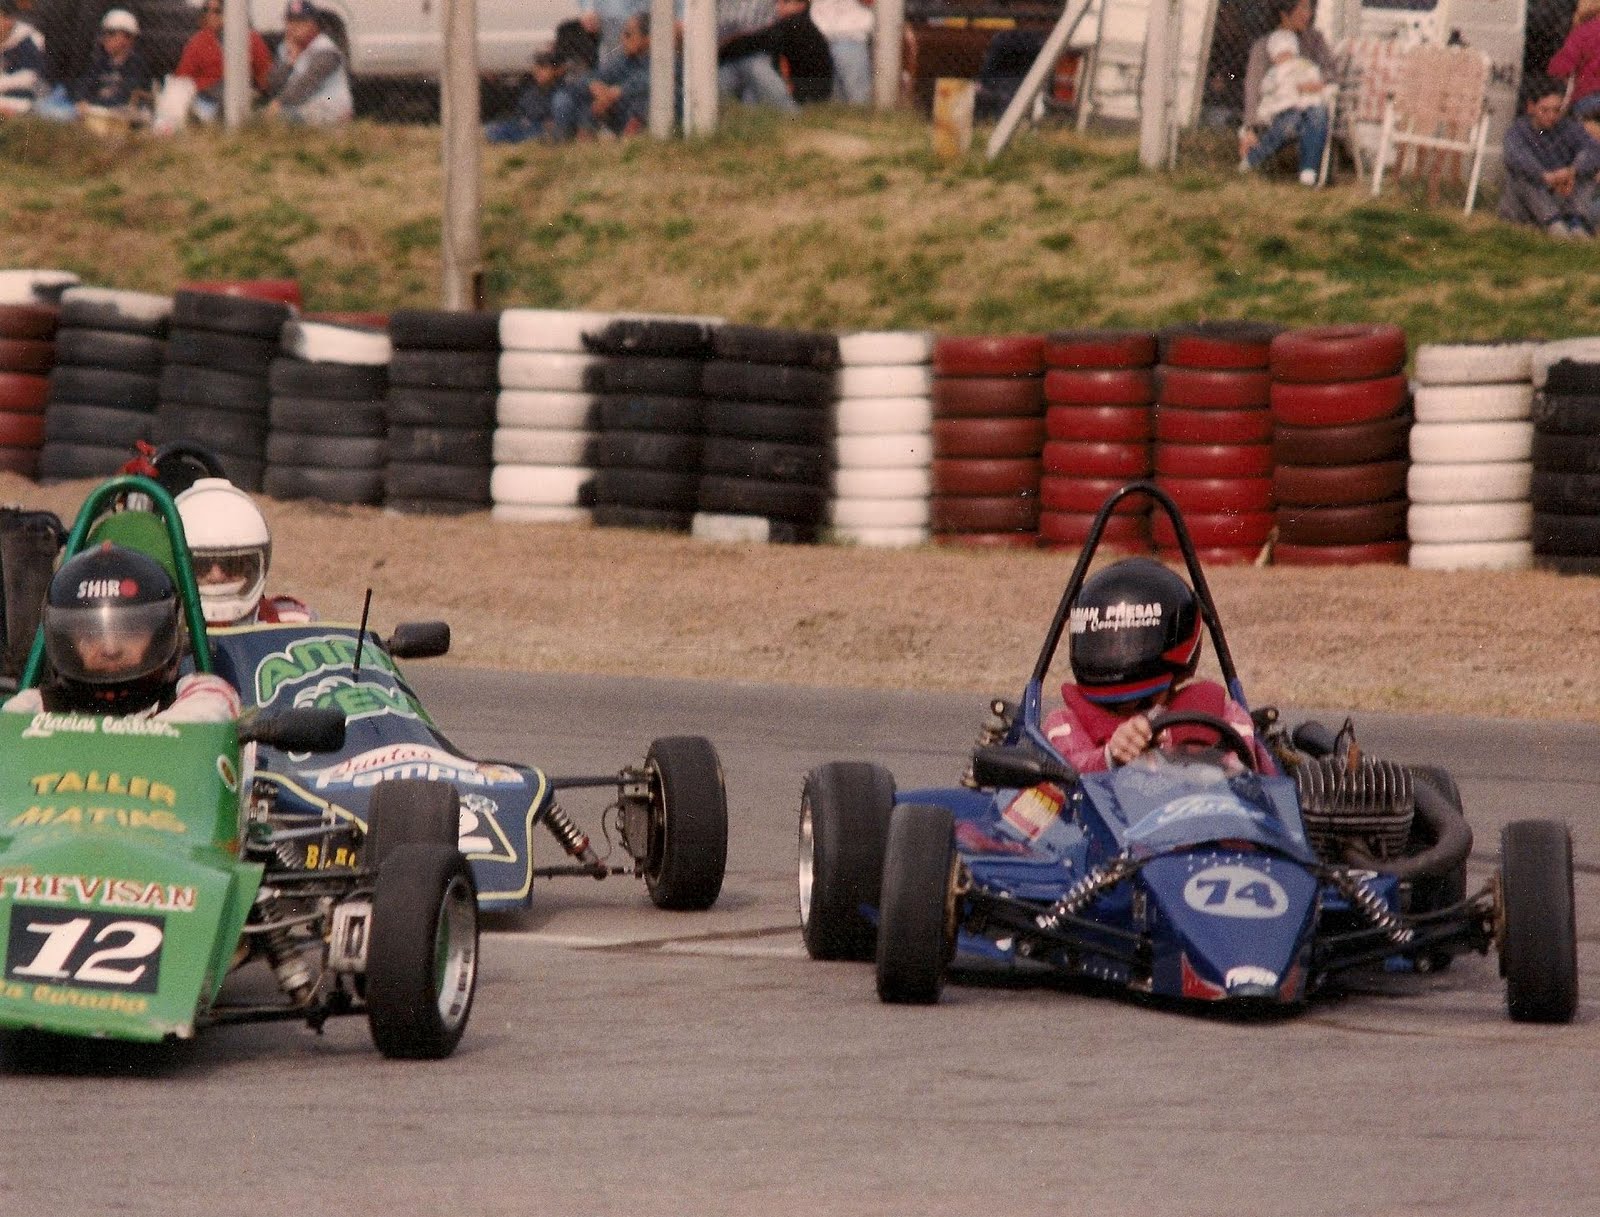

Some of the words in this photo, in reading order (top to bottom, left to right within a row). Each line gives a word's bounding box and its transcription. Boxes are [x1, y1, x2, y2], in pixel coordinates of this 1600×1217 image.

[29, 770, 177, 808] TALLER
[0, 874, 198, 912] TREVISAN
[1196, 879, 1277, 910] 74
[12, 917, 163, 984] 12
